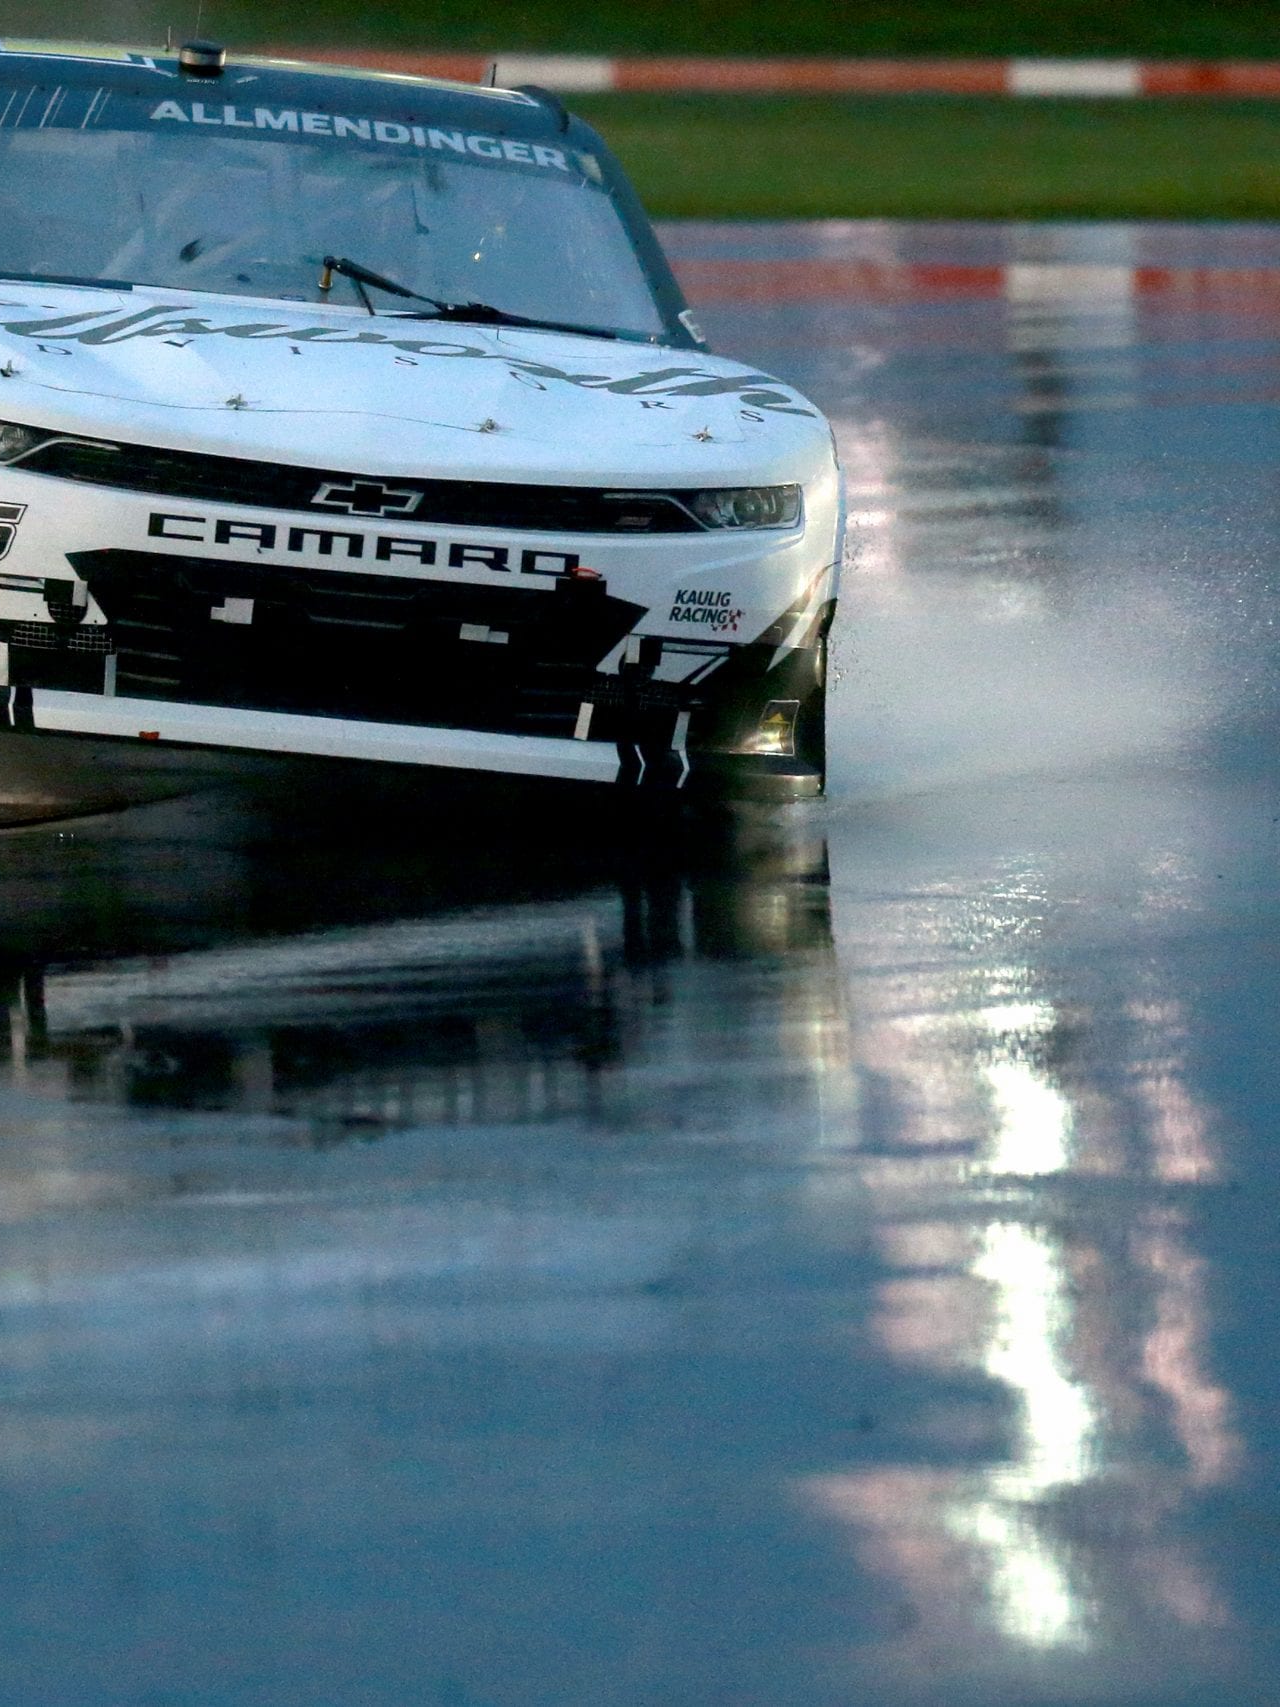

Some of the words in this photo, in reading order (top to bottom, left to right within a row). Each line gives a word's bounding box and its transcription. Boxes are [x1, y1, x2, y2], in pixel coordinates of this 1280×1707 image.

[149, 100, 570, 171] ALLMENDINGER
[147, 512, 581, 577] CAMARO
[669, 606, 729, 624] RACING
[674, 589, 732, 607] KAULIG
